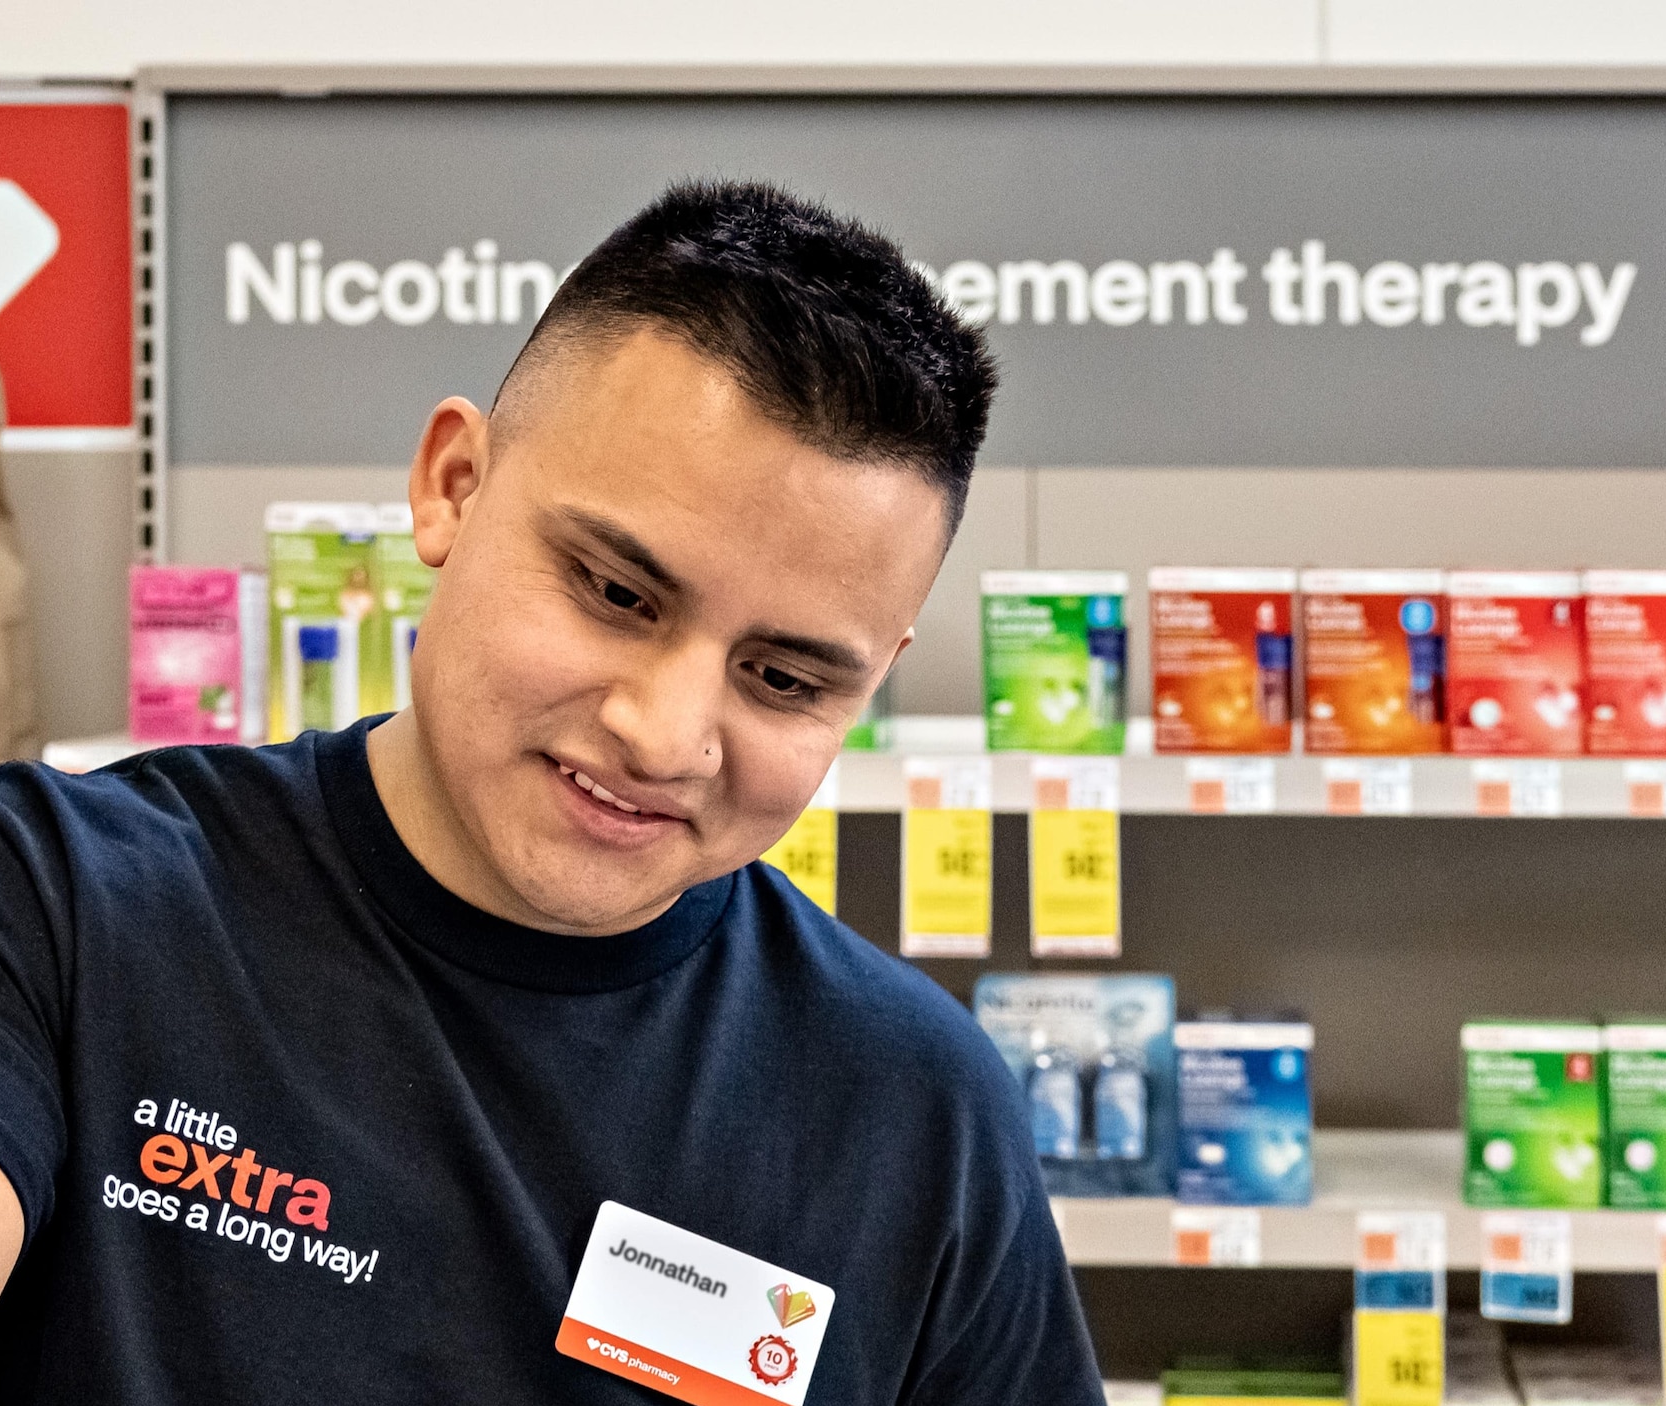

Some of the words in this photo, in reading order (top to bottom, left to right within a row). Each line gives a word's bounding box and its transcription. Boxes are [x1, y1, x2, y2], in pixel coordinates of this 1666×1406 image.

[224, 238, 583, 327] Nicotin
[1262, 239, 1638, 347] therapy
[133, 1098, 159, 1128] a
[163, 1097, 238, 1152] little
[139, 1132, 332, 1232] extra
[102, 1174, 181, 1222] goes
[185, 1203, 210, 1232] a
[215, 1202, 296, 1263] long
[302, 1235, 380, 1285] way!
[608, 1238, 728, 1299] Jonnathan
[766, 1350, 783, 1366] 10
